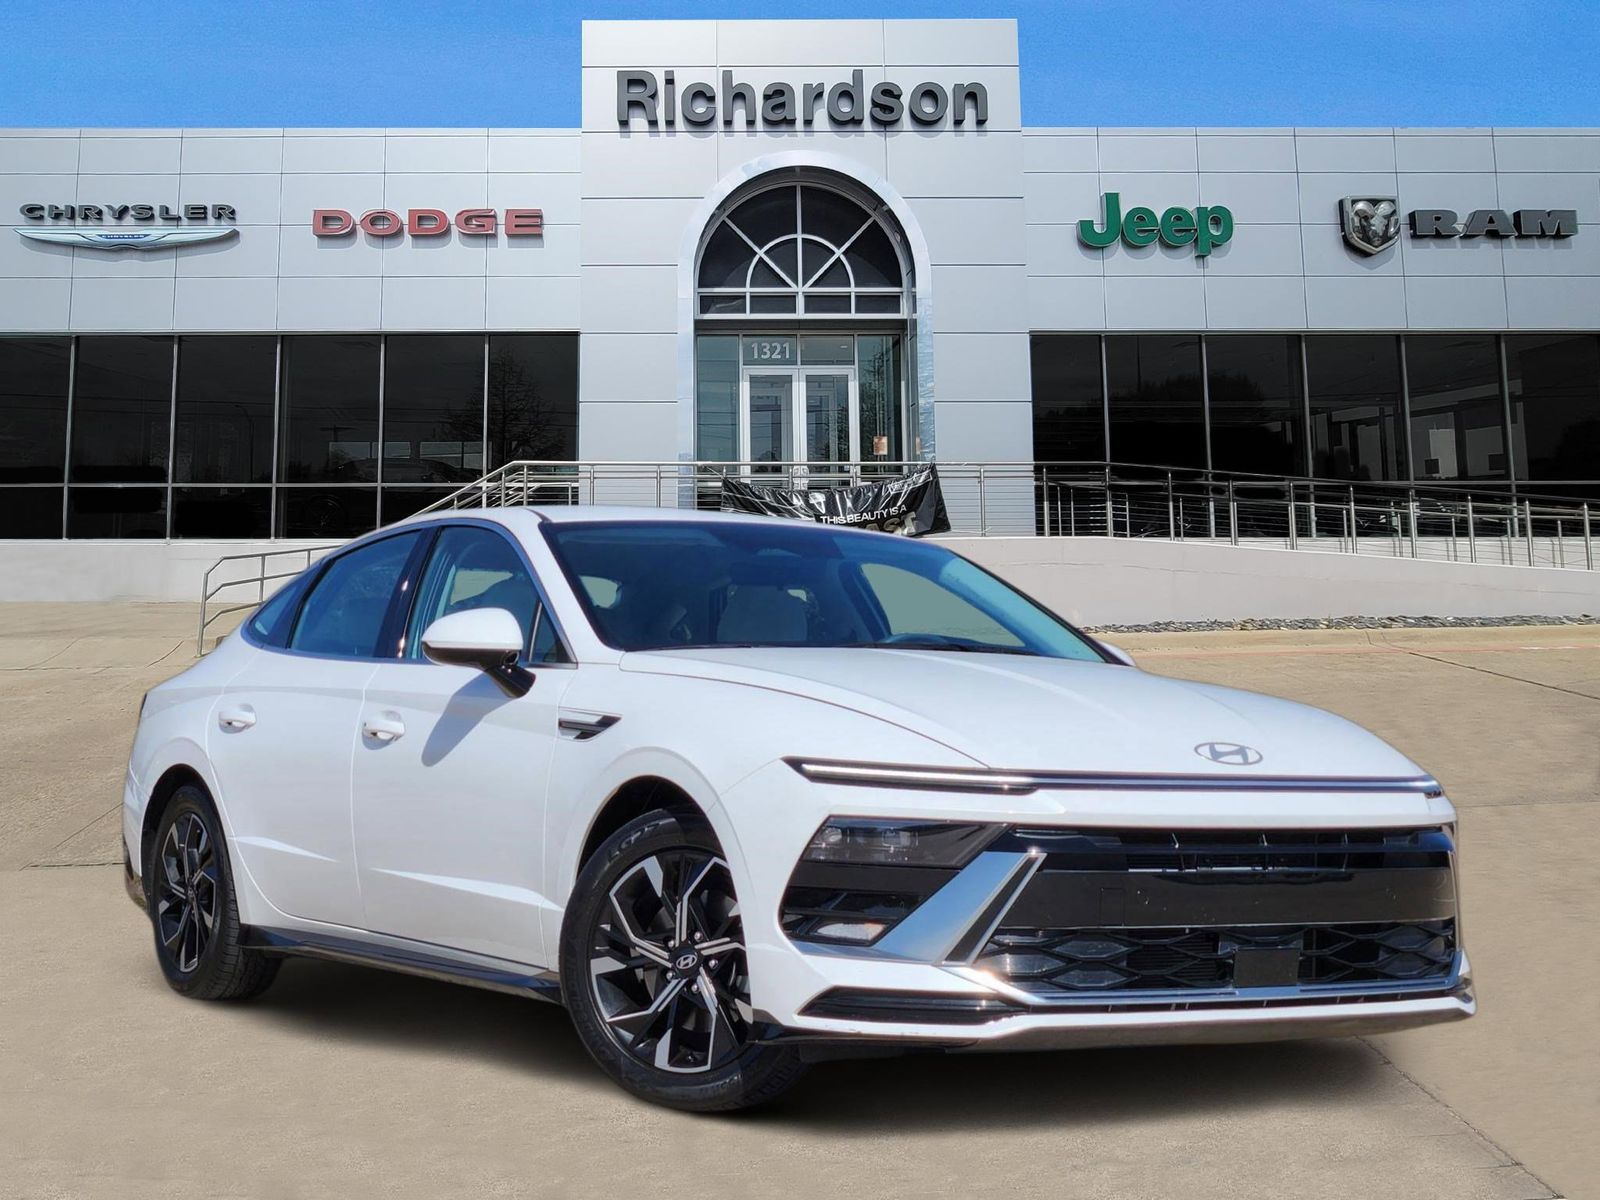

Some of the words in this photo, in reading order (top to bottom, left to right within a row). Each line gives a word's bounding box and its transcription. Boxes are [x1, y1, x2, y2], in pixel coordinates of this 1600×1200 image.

[616, 70, 988, 125] Richardson
[20, 203, 236, 219] CHRYSLER
[312, 208, 544, 236] DODGE
[1076, 192, 1233, 257] Jeep
[1408, 209, 1578, 238] RAM
[751, 342, 790, 359] 1321
[820, 516, 846, 524] THIS
[847, 510, 887, 523] BEAUTY
[889, 506, 899, 515] IS
[899, 504, 907, 513] A
